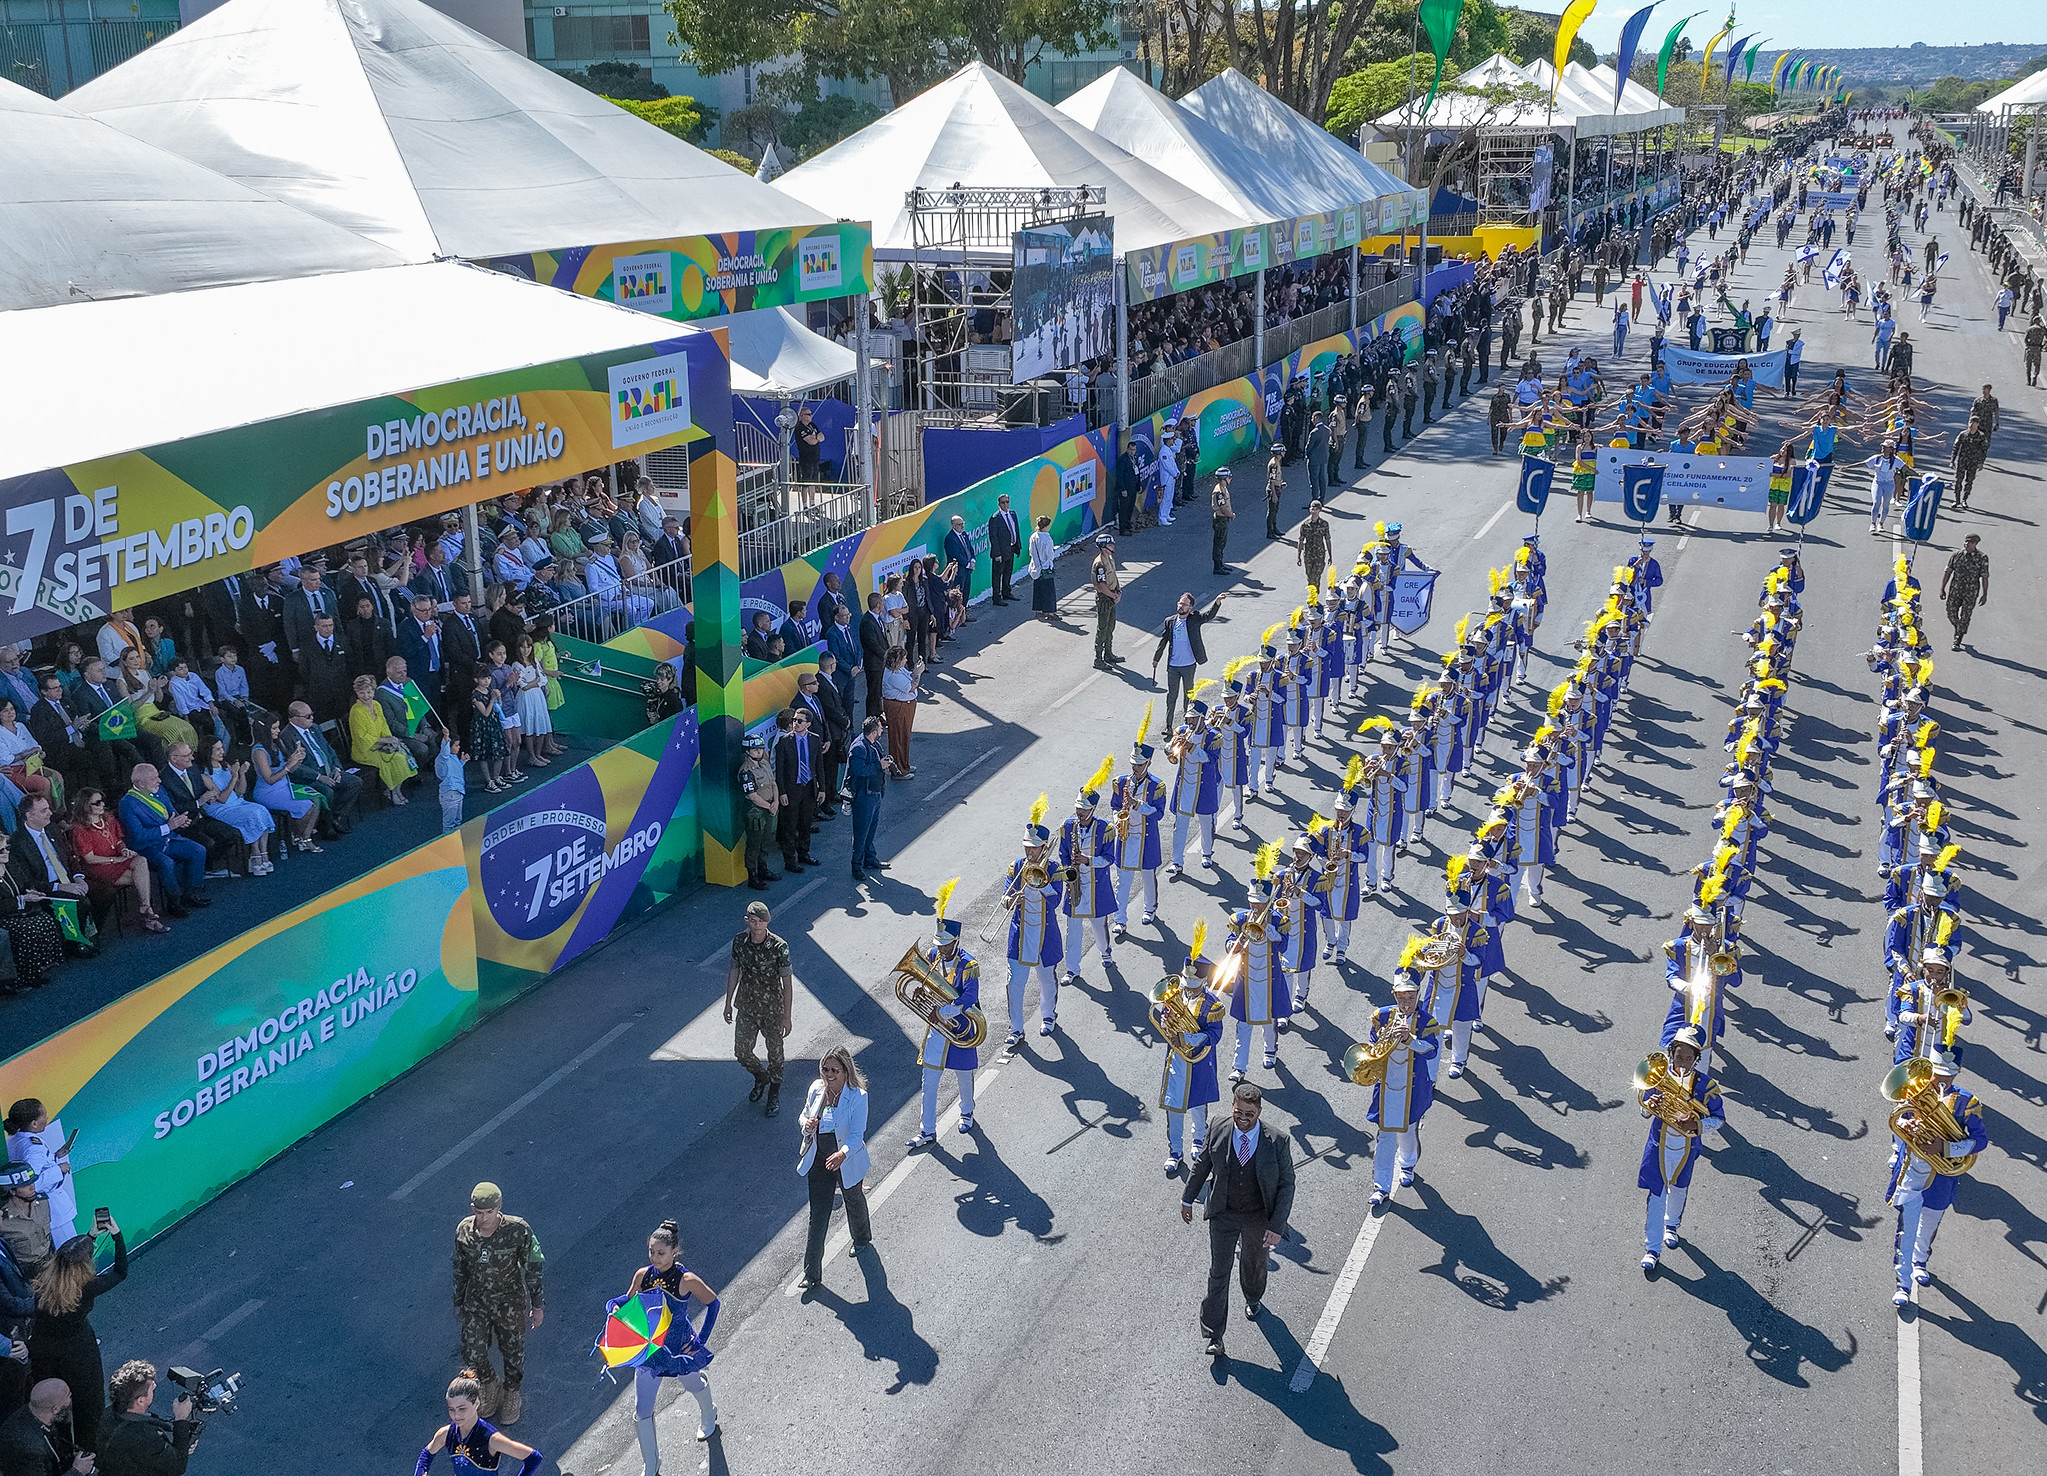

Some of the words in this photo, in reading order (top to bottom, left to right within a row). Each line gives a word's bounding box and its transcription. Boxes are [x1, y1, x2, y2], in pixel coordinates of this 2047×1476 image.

[705, 271, 749, 292] SOBERANIA
[750, 271, 755, 286] E
[755, 265, 778, 285] UNIÃO
[717, 253, 766, 272] DEMOCRACIA,
[619, 271, 667, 300] BRASIL
[622, 372, 650, 384] GOVERNO
[651, 367, 676, 378] FEDERAL
[1677, 360, 1702, 368] GRUPO
[617, 378, 683, 422] BRASIL
[366, 394, 527, 461] DEMOCRACIA,
[325, 449, 471, 518] SOBERANIA
[476, 443, 490, 478] E
[495, 421, 564, 472] UNIÃO
[1526, 469, 1545, 504] C
[1686, 473, 1741, 482] FUNDAMENTAL
[1633, 478, 1652, 514] E
[5, 498, 55, 615] 7
[64, 485, 118, 545] DE
[52, 504, 255, 601] SETEMBRO
[1400, 595, 1420, 603] GAMA
[1404, 581, 1419, 589] CRE
[743, 600, 748, 608] E
[750, 599, 783, 618] PROGRESS
[1391, 610, 1414, 618] CEF
[743, 782, 754, 793] PE
[483, 821, 525, 849] ORDEM
[530, 816, 536, 827] E
[542, 812, 605, 833] PROGRESSO
[524, 853, 553, 923] 7
[556, 834, 587, 876] DE
[548, 821, 662, 908] SETEMBRO
[197, 966, 376, 1083] DEMOCRACIA,
[153, 1029, 315, 1140] SOBERANIA
[319, 1014, 335, 1044] E
[340, 968, 419, 1029] UNIÃO
